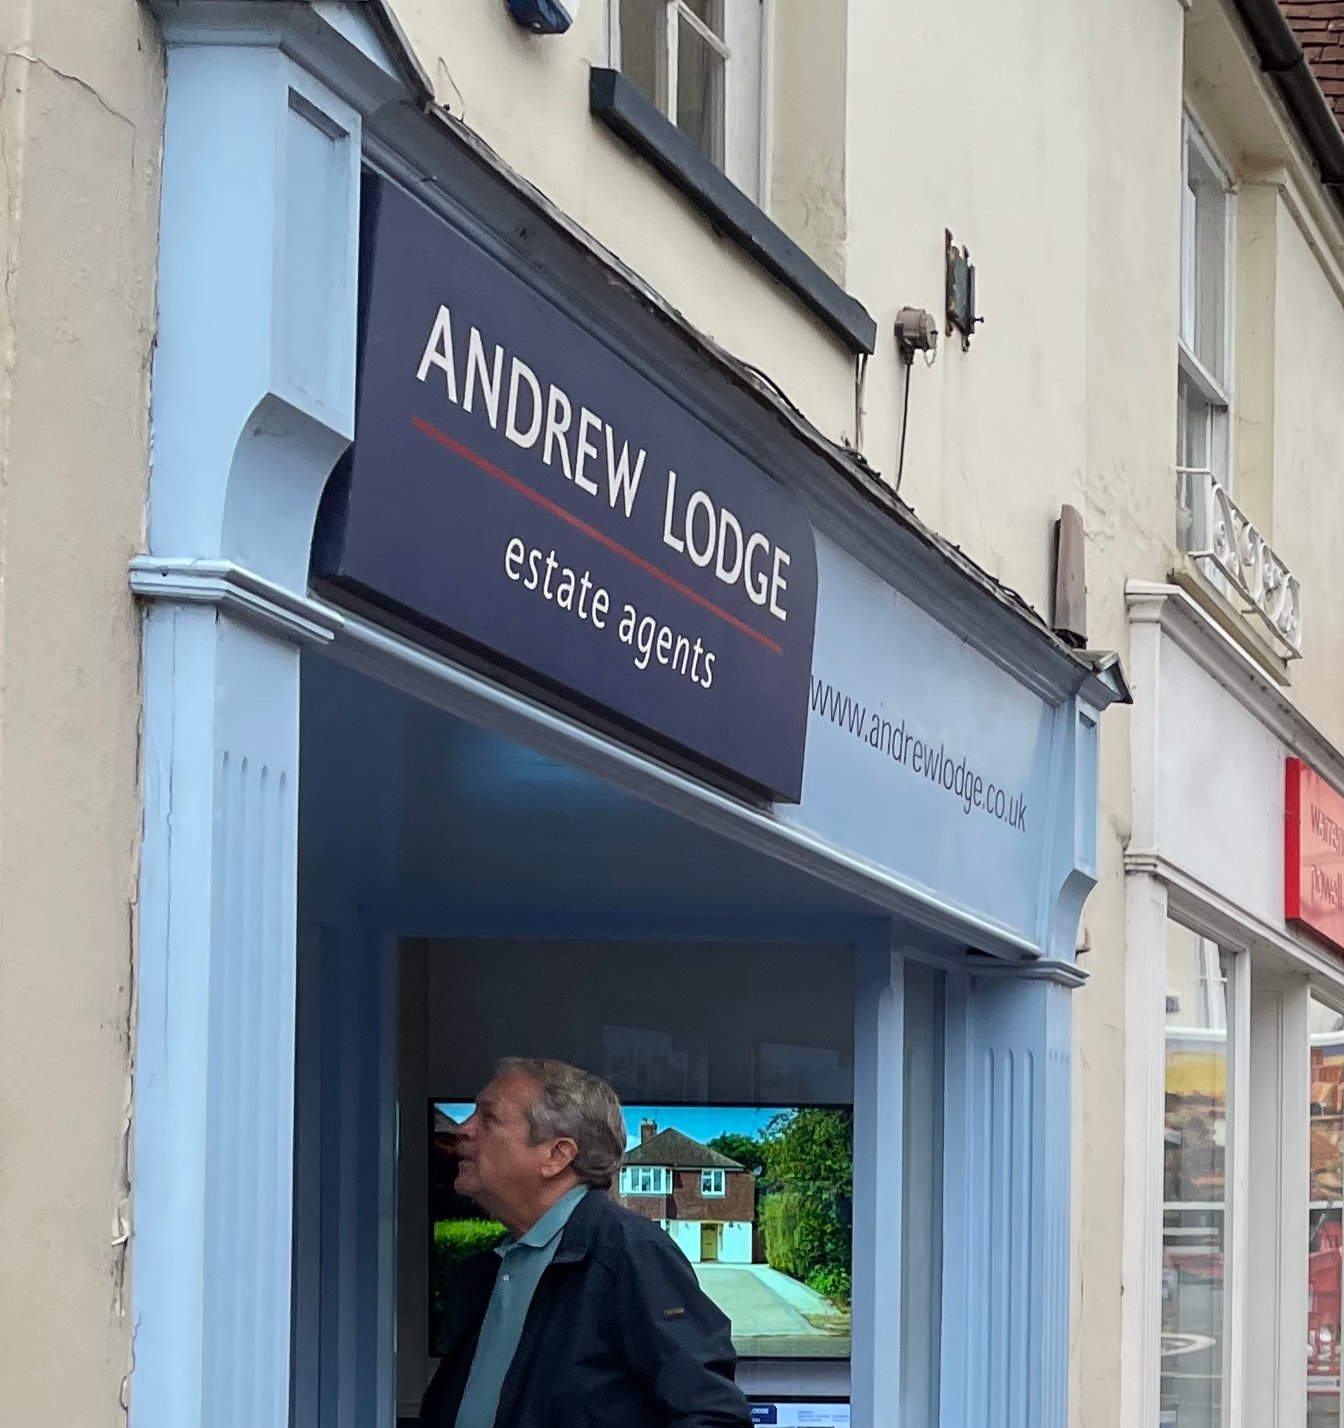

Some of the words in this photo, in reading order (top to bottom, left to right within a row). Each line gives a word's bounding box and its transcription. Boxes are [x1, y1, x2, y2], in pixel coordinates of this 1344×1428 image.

[416, 304, 647, 518] ANDREW
[662, 471, 790, 621] LODGE
[504, 535, 610, 630] estate
[618, 602, 717, 690] agents
[810, 675, 1027, 833] www.andrewlodge.co.uk
